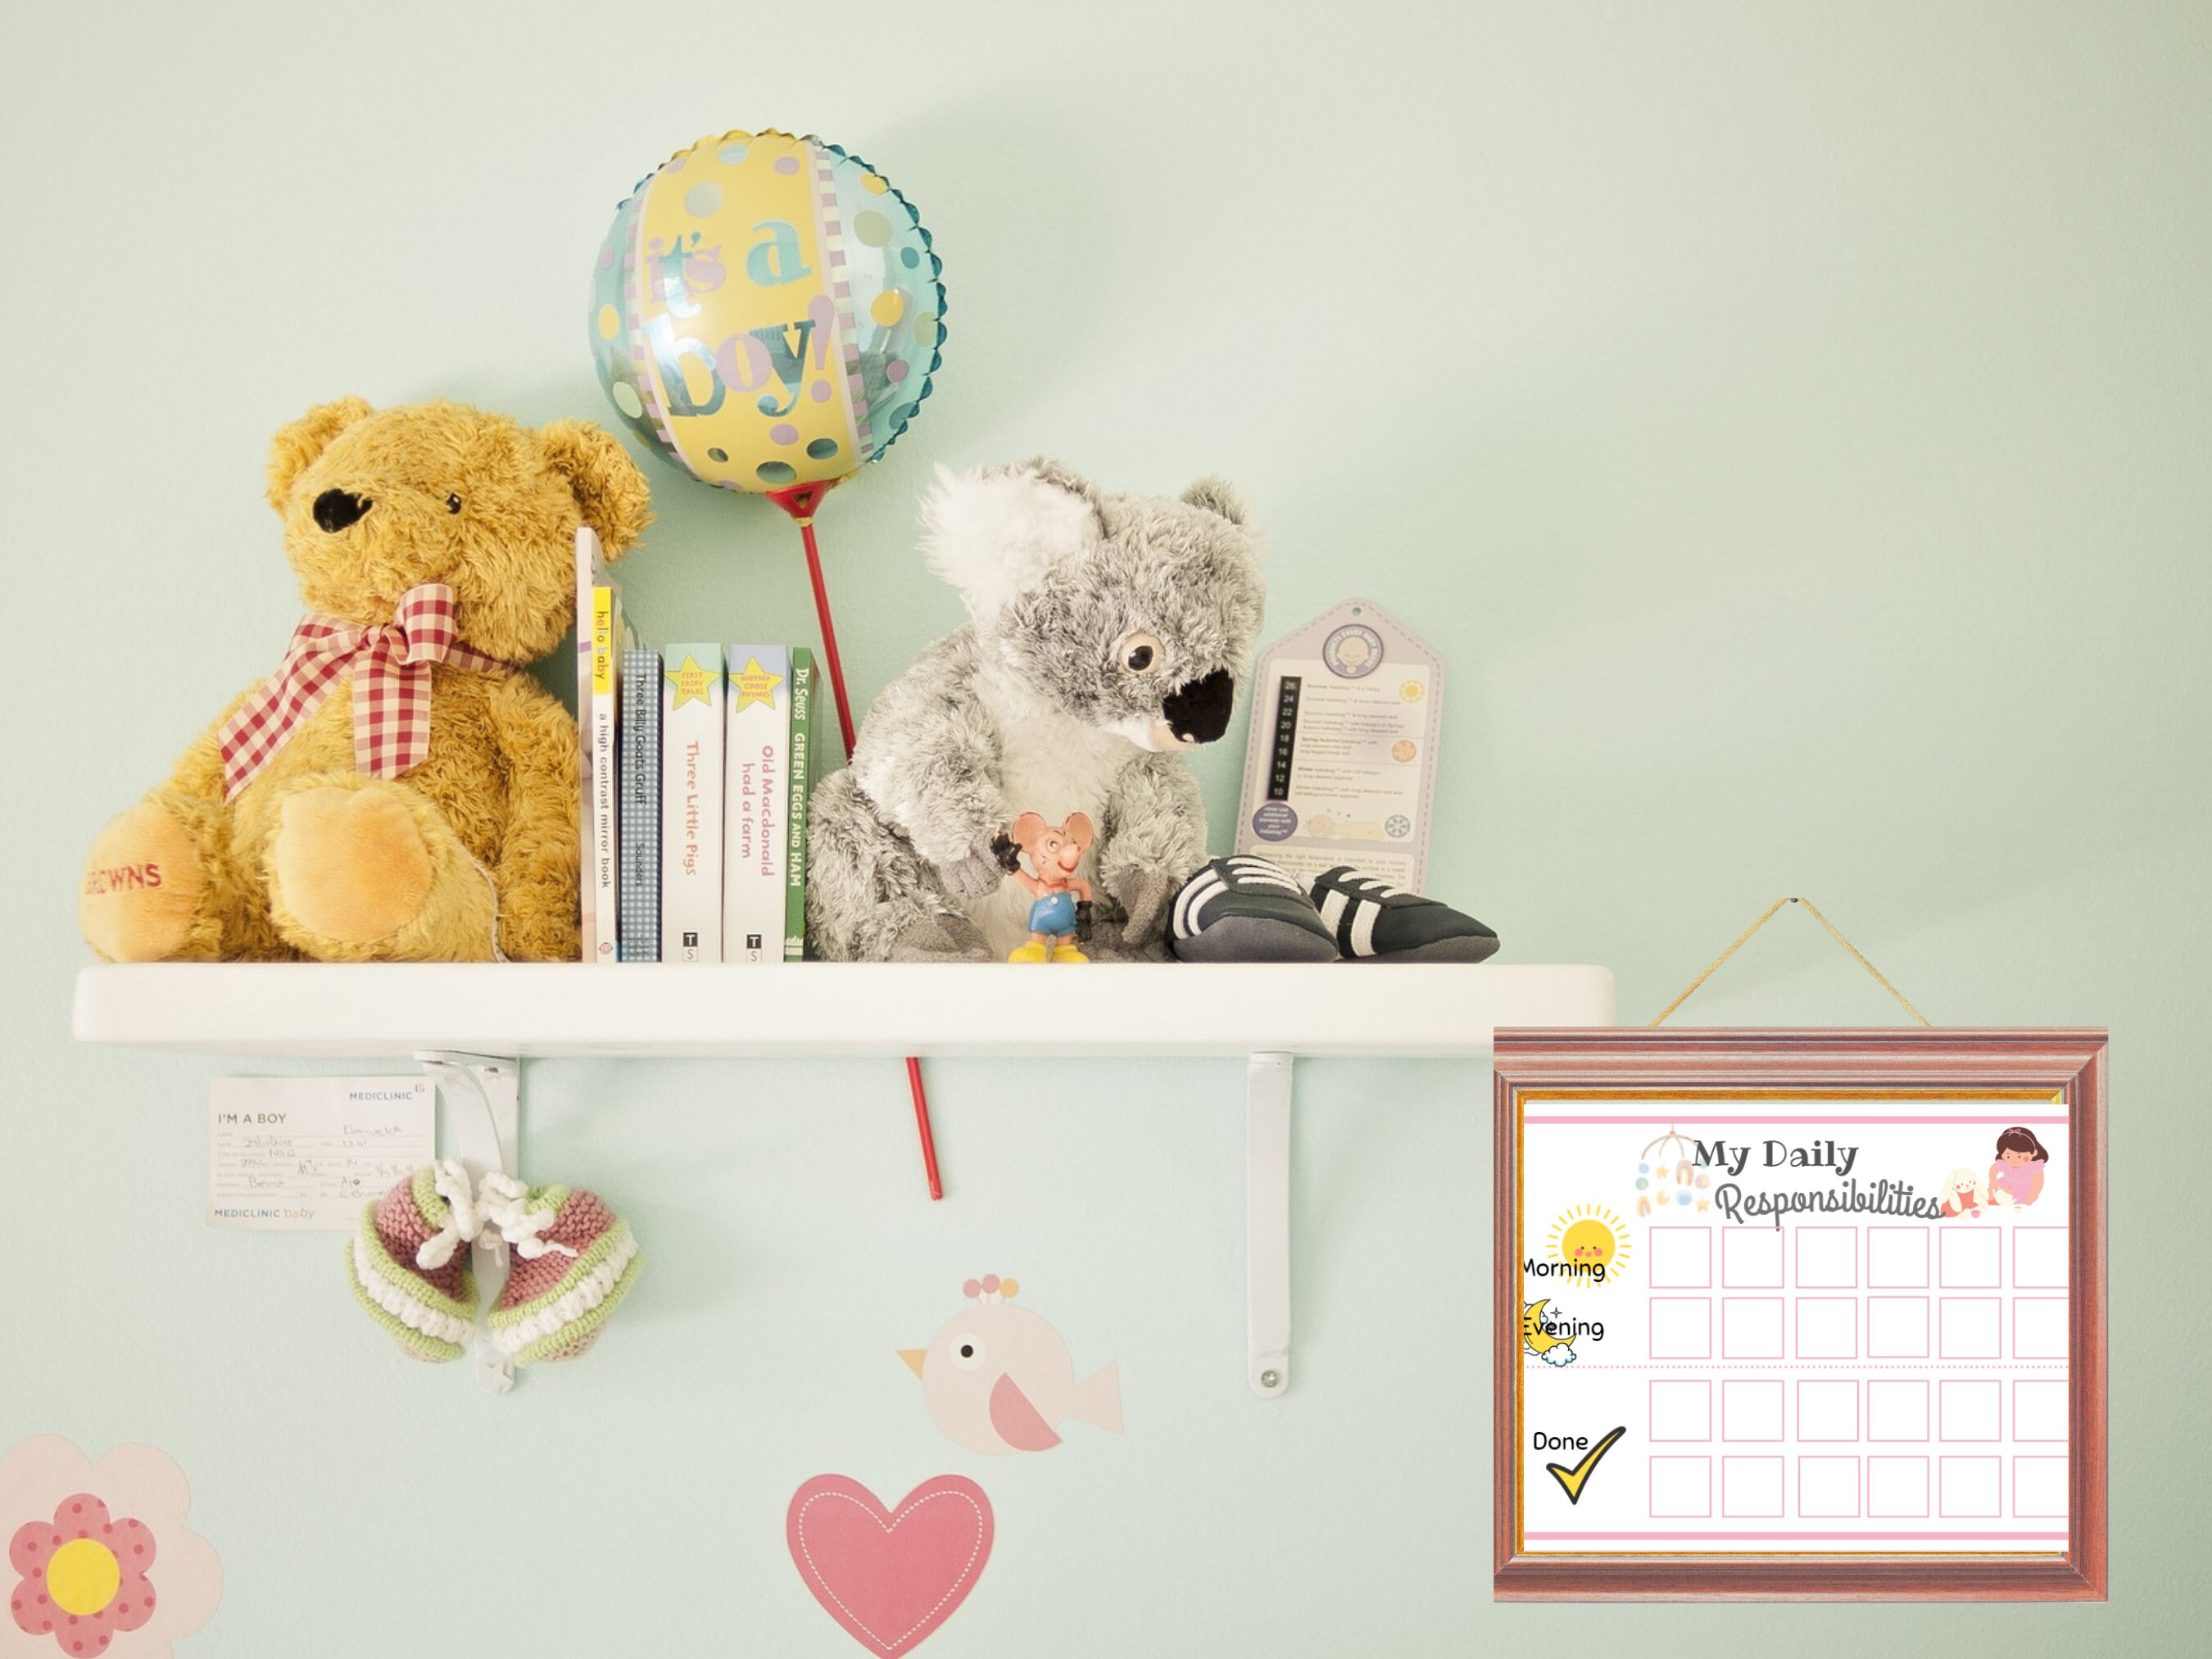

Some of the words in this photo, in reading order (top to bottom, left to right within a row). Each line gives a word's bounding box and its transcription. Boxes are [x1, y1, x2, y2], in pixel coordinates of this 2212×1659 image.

[645, 231, 727, 319] it's
[746, 219, 813, 287] a
[641, 294, 836, 418] boy!
[596, 610, 610, 643] hello
[595, 646, 610, 680] baby
[795, 668, 809, 686] Dr.
[635, 673, 647, 705] Three
[681, 688, 704, 696] TALES
[794, 689, 809, 721] Seuss
[599, 713, 608, 721] a
[633, 709, 647, 732] Billy
[597, 724, 610, 753] high
[635, 736, 647, 770] Goats
[686, 740, 700, 791] Three
[761, 745, 776, 774] Old
[792, 732, 806, 781] GREEN
[599, 756, 610, 810] contrast
[635, 773, 647, 805] Gruff
[741, 762, 756, 796] had
[686, 793, 699, 841] Little
[741, 800, 751, 813] a
[791, 784, 805, 820] EGGS
[600, 814, 611, 854] mirror
[741, 816, 754, 859] farm
[760, 777, 776, 877] Macdonald
[791, 823, 802, 849] AND
[601, 857, 612, 889] book
[635, 842, 646, 887] Saunders
[682, 843, 699, 877] Pigs
[789, 852, 802, 887] HAM
[348, 1091, 414, 1101] MEDICLINIC
[217, 1113, 238, 1125] I'M
[243, 1113, 253, 1125] A
[256, 1113, 288, 1125] BOY
[1692, 1140, 1752, 1176] My
[1762, 1140, 1860, 1176] Daily
[214, 1208, 281, 1219] MEDICLINIC
[283, 1208, 315, 1222] baby
[1714, 1177, 1947, 1232] Responsibilities
[1524, 1258, 1607, 1283] Morning
[1524, 1317, 1605, 1342] Evening
[1533, 1431, 1589, 1451] Done
